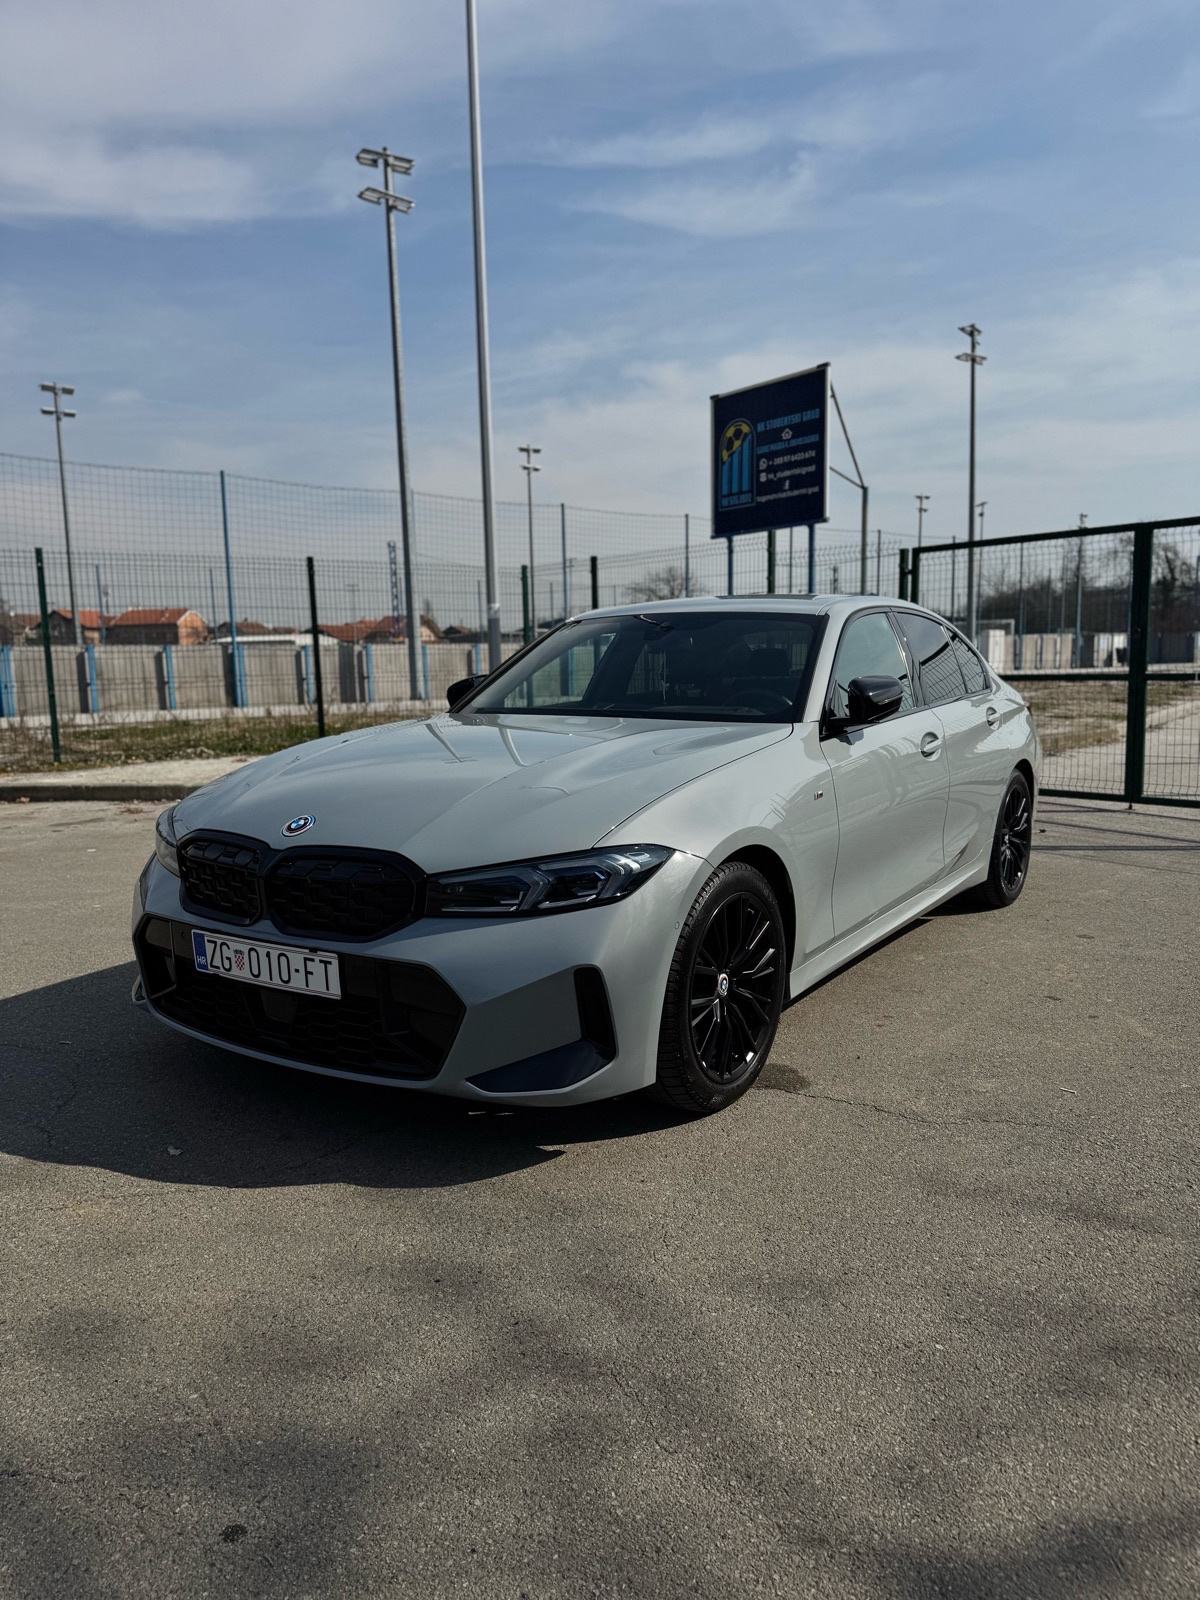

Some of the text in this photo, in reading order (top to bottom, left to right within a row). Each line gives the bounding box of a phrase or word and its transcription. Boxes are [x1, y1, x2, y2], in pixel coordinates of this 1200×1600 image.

[196, 955, 207, 966] HR
[206, 938, 332, 992] ZG 010-FT
